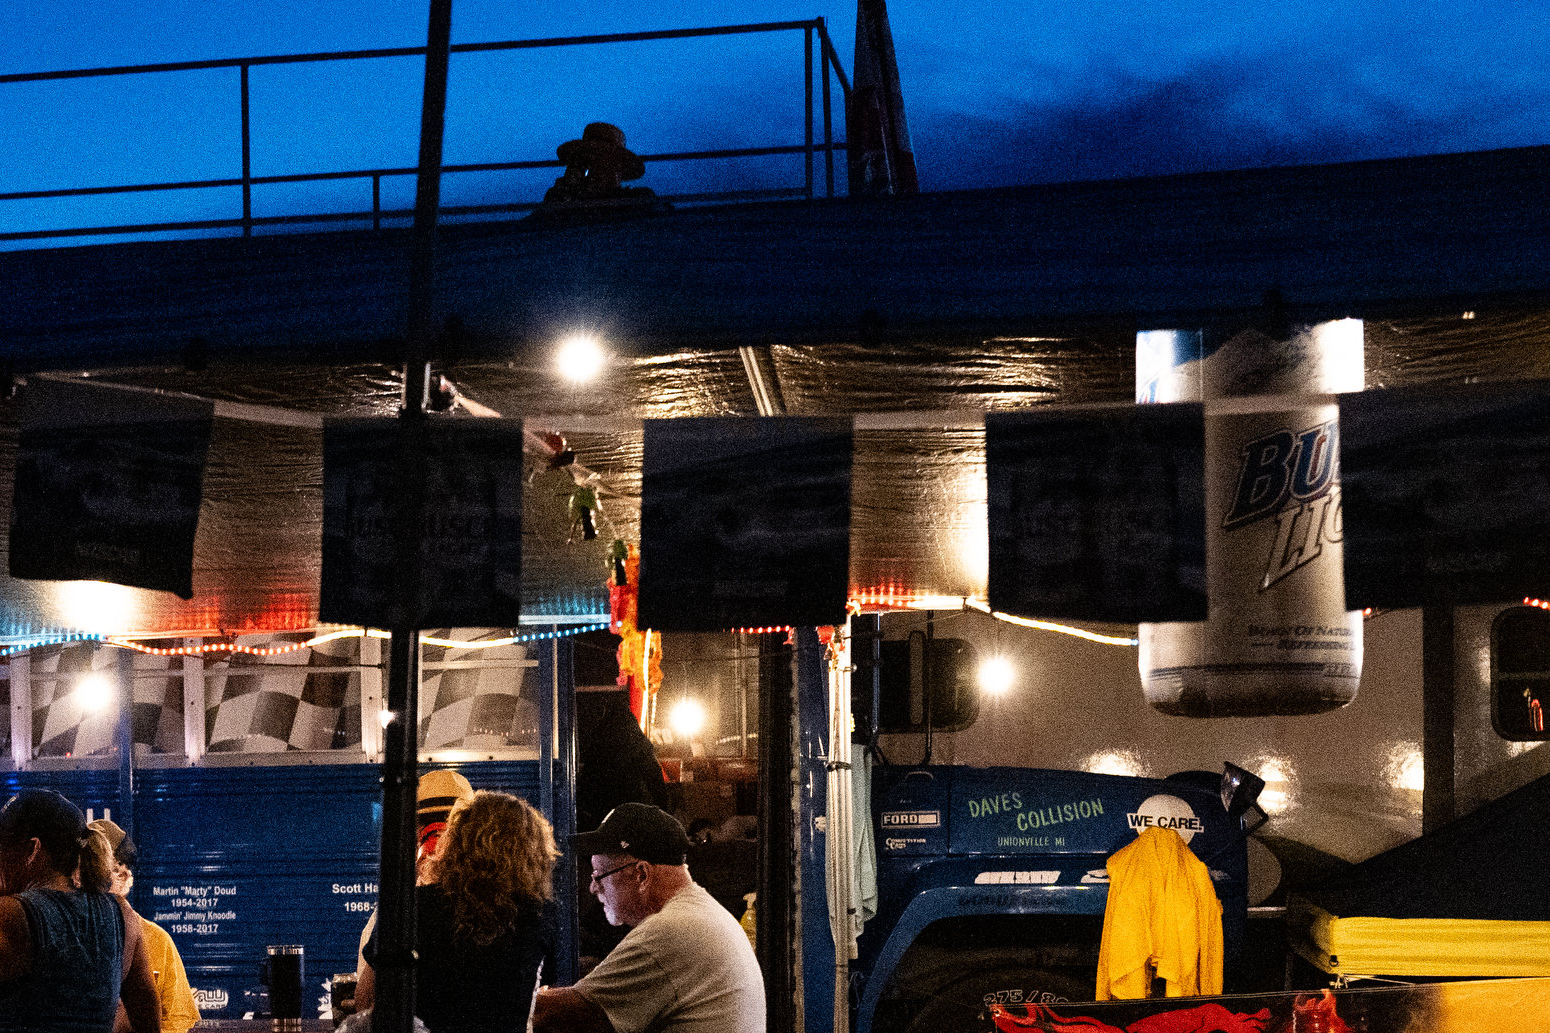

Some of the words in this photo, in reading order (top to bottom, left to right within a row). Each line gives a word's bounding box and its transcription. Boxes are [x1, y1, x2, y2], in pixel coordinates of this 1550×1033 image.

[1223, 420, 1341, 531] BU
[883, 814, 918, 825] FORD
[1017, 798, 1104, 831] COLLISION
[1130, 815, 1153, 829] WE
[997, 836, 1050, 847] UNIONVILLE
[1055, 837, 1066, 846] MI
[153, 886, 179, 896] Martin
[181, 886, 212, 898] "Marty"
[214, 886, 237, 895] Doud
[331, 883, 361, 894] Scott
[364, 883, 379, 894] Ha
[171, 898, 218, 907] 1954-2017
[184, 911, 207, 922] Jimmy
[208, 911, 237, 920] Knoodle
[171, 924, 219, 934] 1958-2017
